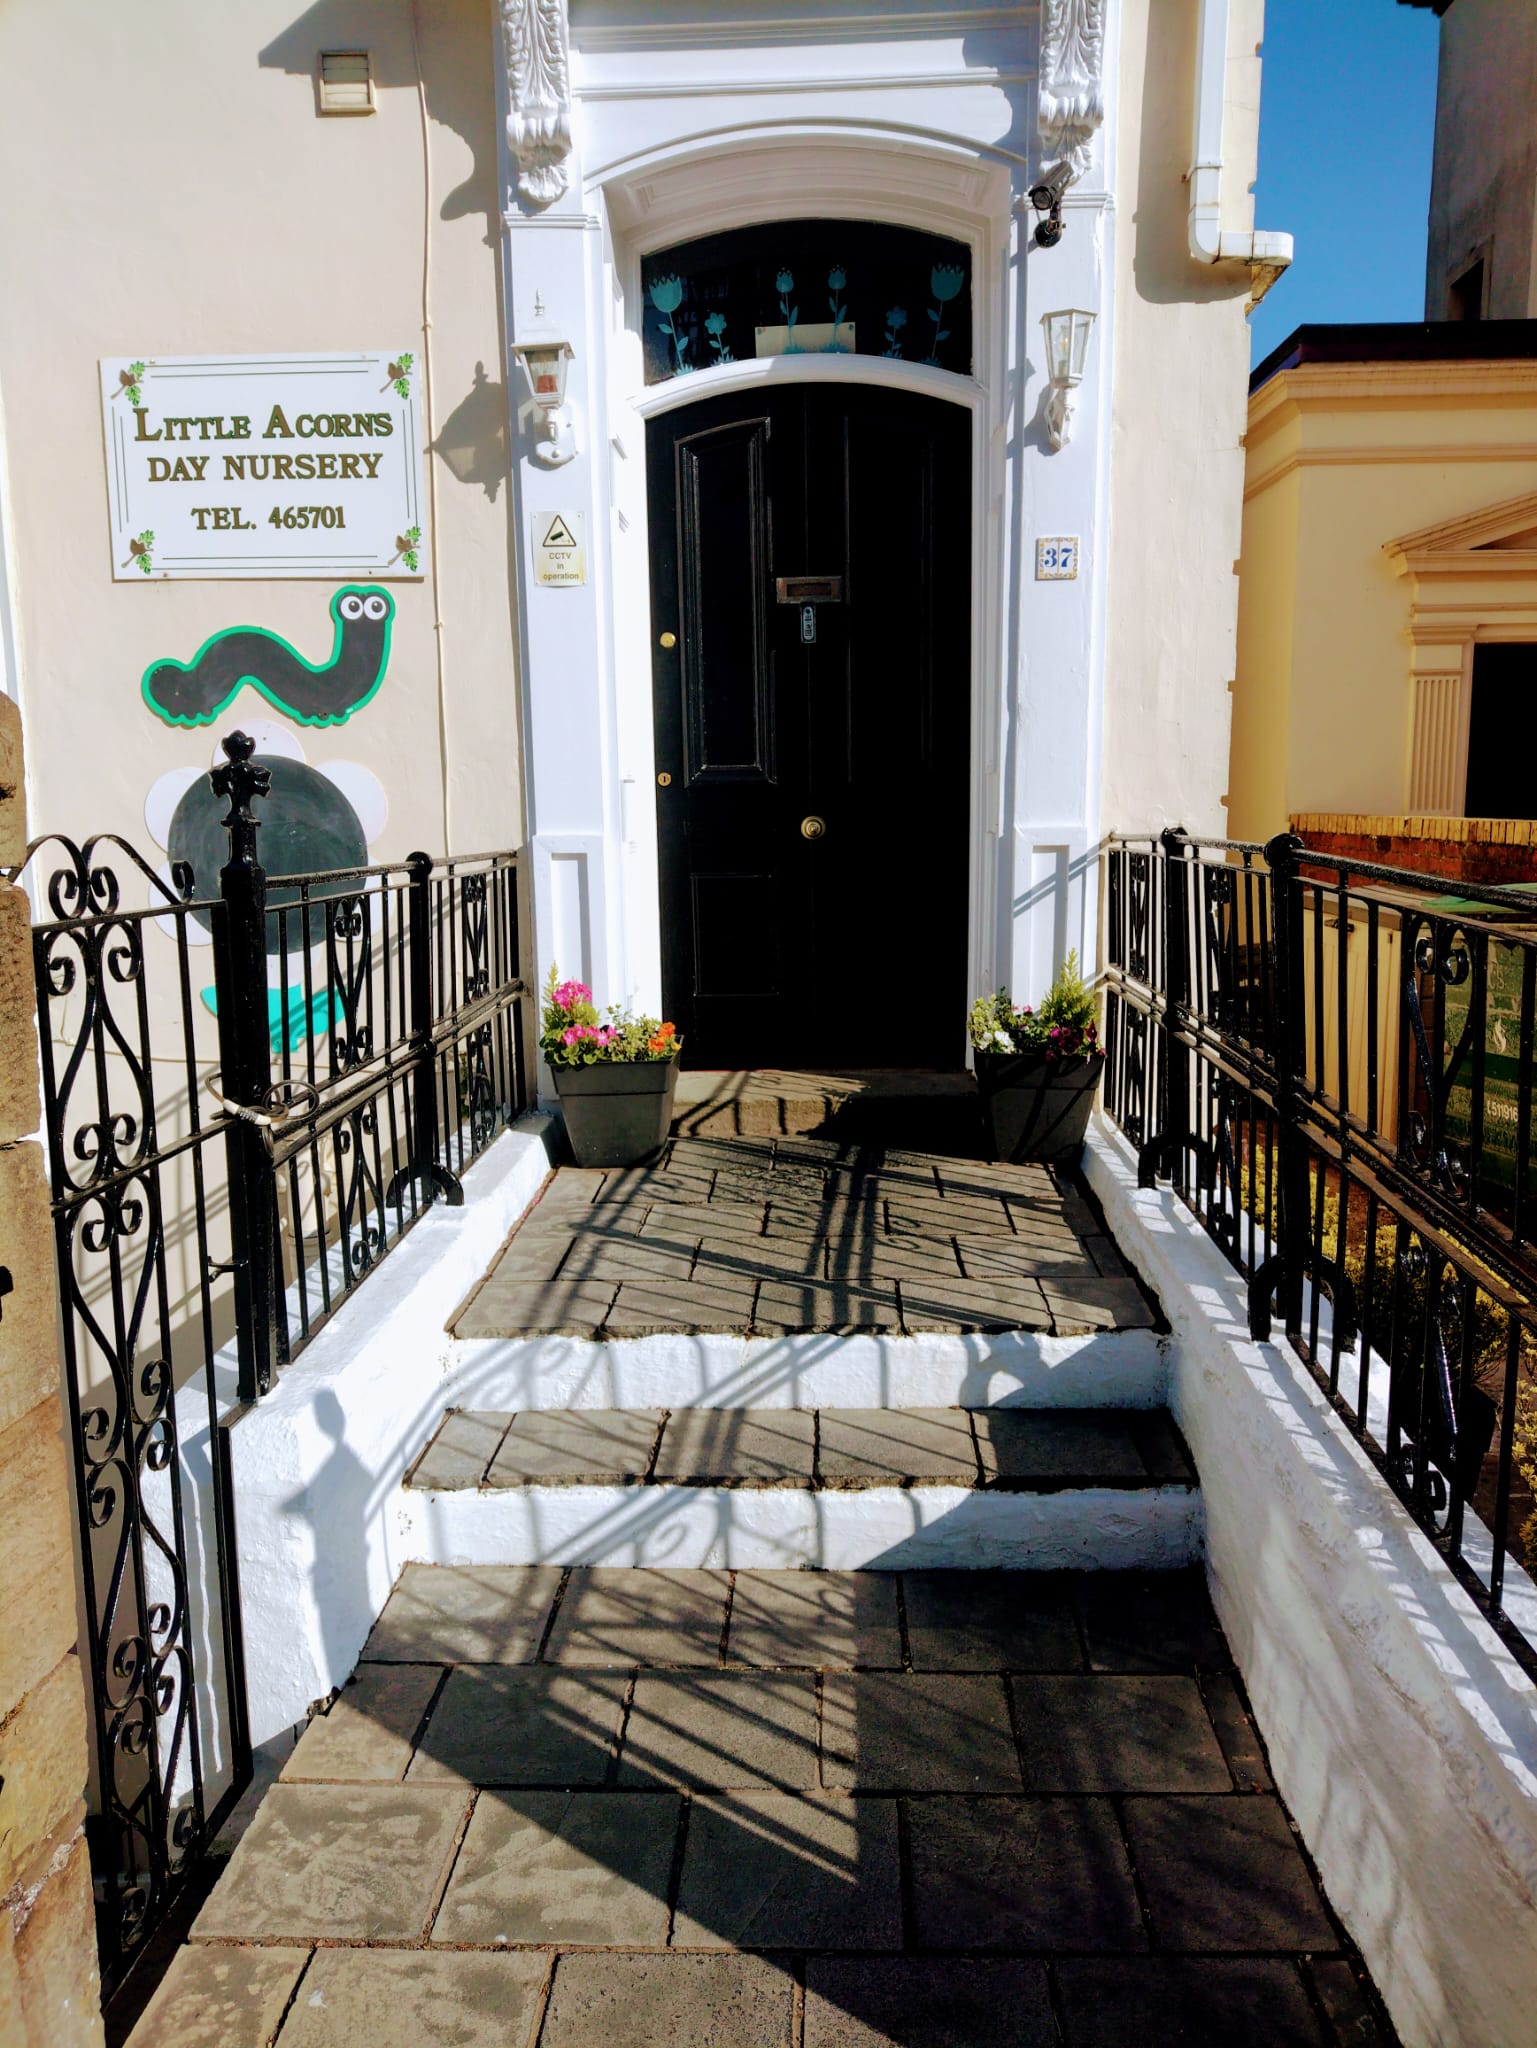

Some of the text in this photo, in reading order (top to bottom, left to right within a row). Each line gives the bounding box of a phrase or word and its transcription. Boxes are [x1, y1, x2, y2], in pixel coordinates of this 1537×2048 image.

[132, 404, 394, 441] LITTLE ACORNS
[147, 453, 383, 482] DAY NURSERY
[191, 506, 346, 530] TEL. 465701
[548, 552, 572, 560] CCTV
[1044, 547, 1073, 568] 37
[543, 572, 580, 581] operation
